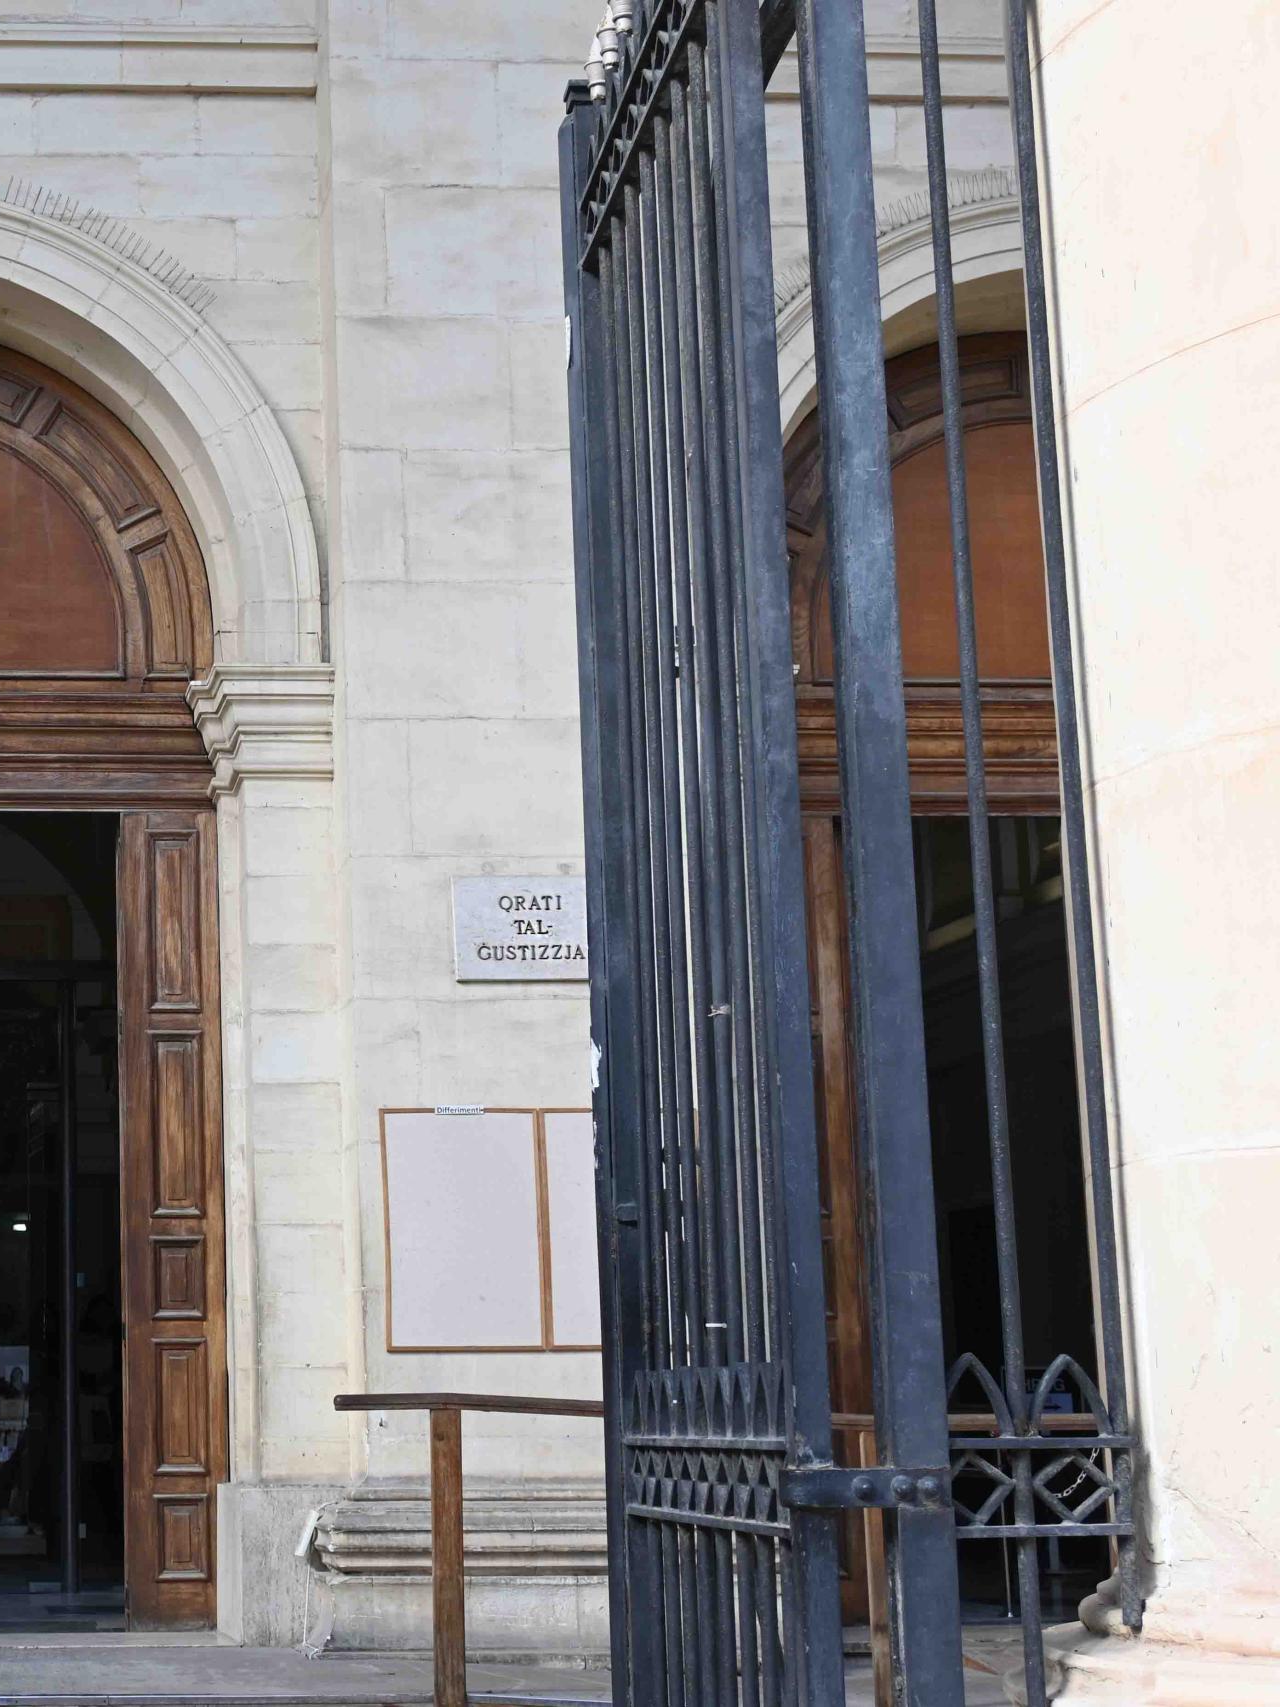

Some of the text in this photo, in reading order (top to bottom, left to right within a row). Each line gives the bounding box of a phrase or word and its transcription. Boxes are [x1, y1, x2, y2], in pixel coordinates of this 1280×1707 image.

[498, 895, 562, 912] QRATI
[513, 919, 553, 935] TAL-
[477, 943, 586, 961] ĠUSTIZZJA
